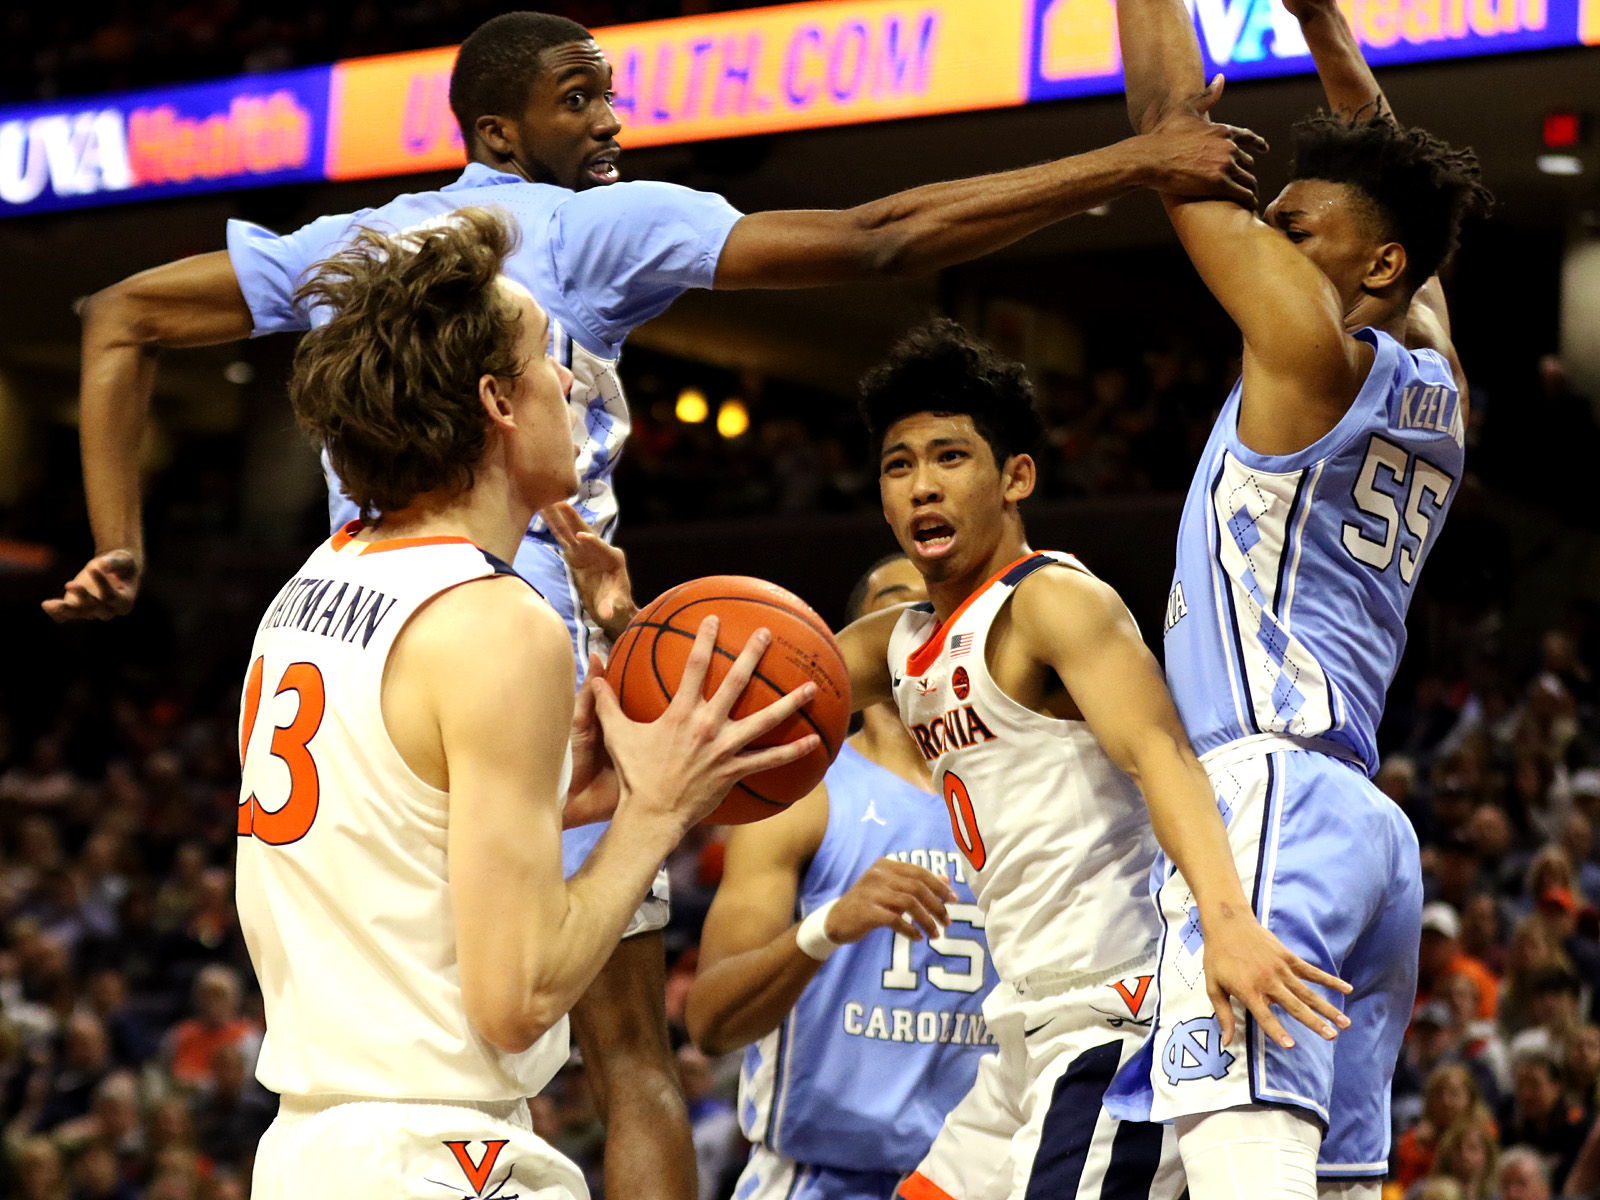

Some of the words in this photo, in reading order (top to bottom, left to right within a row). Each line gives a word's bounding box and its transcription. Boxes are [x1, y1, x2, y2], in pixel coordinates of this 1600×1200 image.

[0, 107, 131, 205] UVA
[1340, 432, 1455, 588] 55
[942, 769, 986, 872] 0
[881, 902, 987, 993] 15
